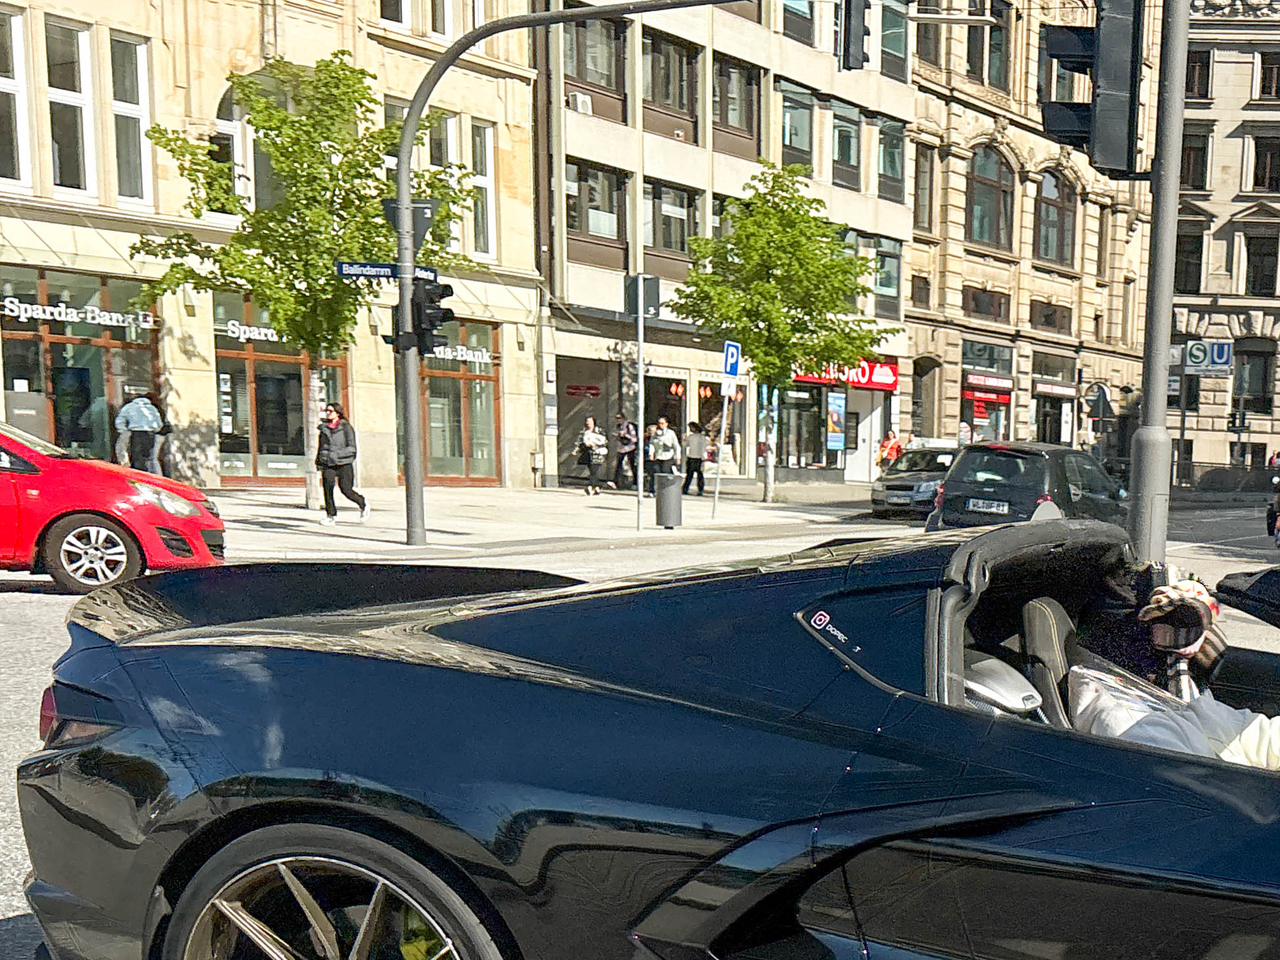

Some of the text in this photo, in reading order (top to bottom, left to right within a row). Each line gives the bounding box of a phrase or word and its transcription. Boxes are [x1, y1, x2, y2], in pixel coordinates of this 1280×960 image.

[342, 264, 392, 276] Ballindamm
[726, 346, 738, 373] P
[1190, 344, 1229, 364] S U
